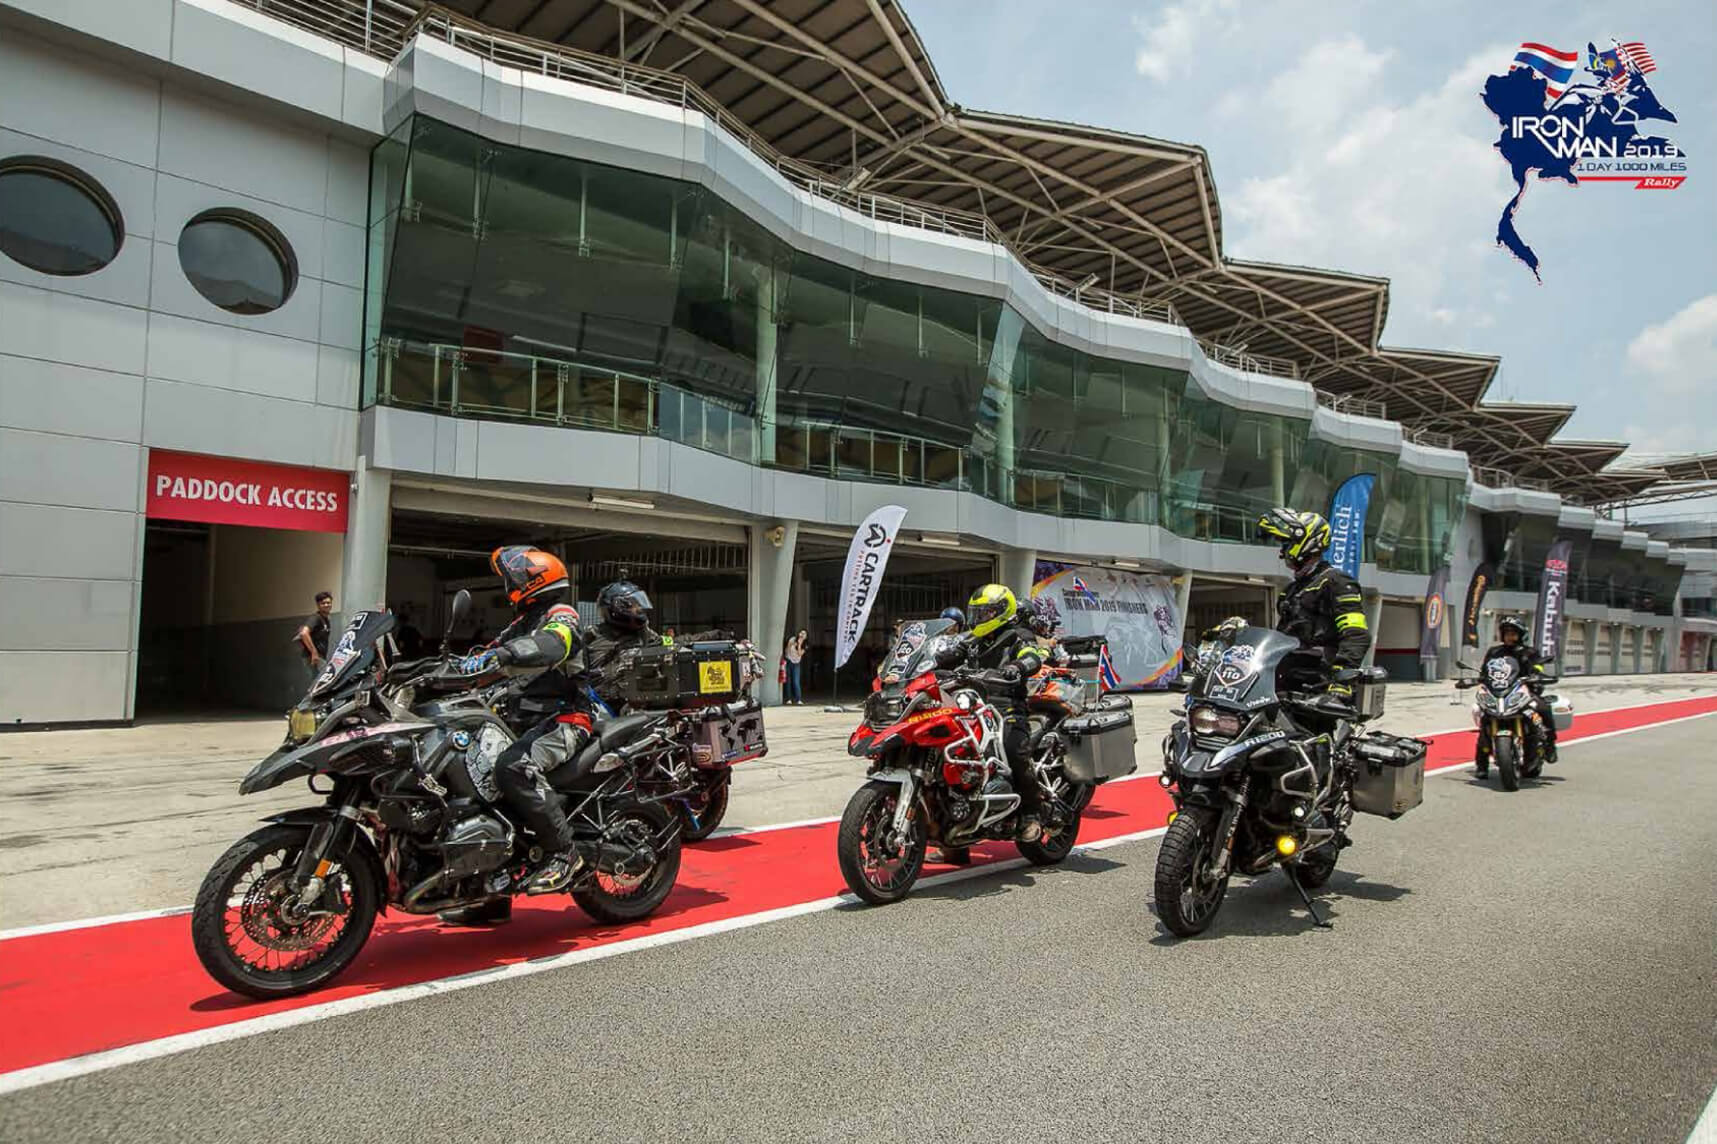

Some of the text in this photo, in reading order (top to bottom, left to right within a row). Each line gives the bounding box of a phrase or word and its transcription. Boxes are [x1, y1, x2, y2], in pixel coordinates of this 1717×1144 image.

[156, 475, 338, 513] PADDOCK ACCESS
[848, 552, 878, 643] CARTRACK
